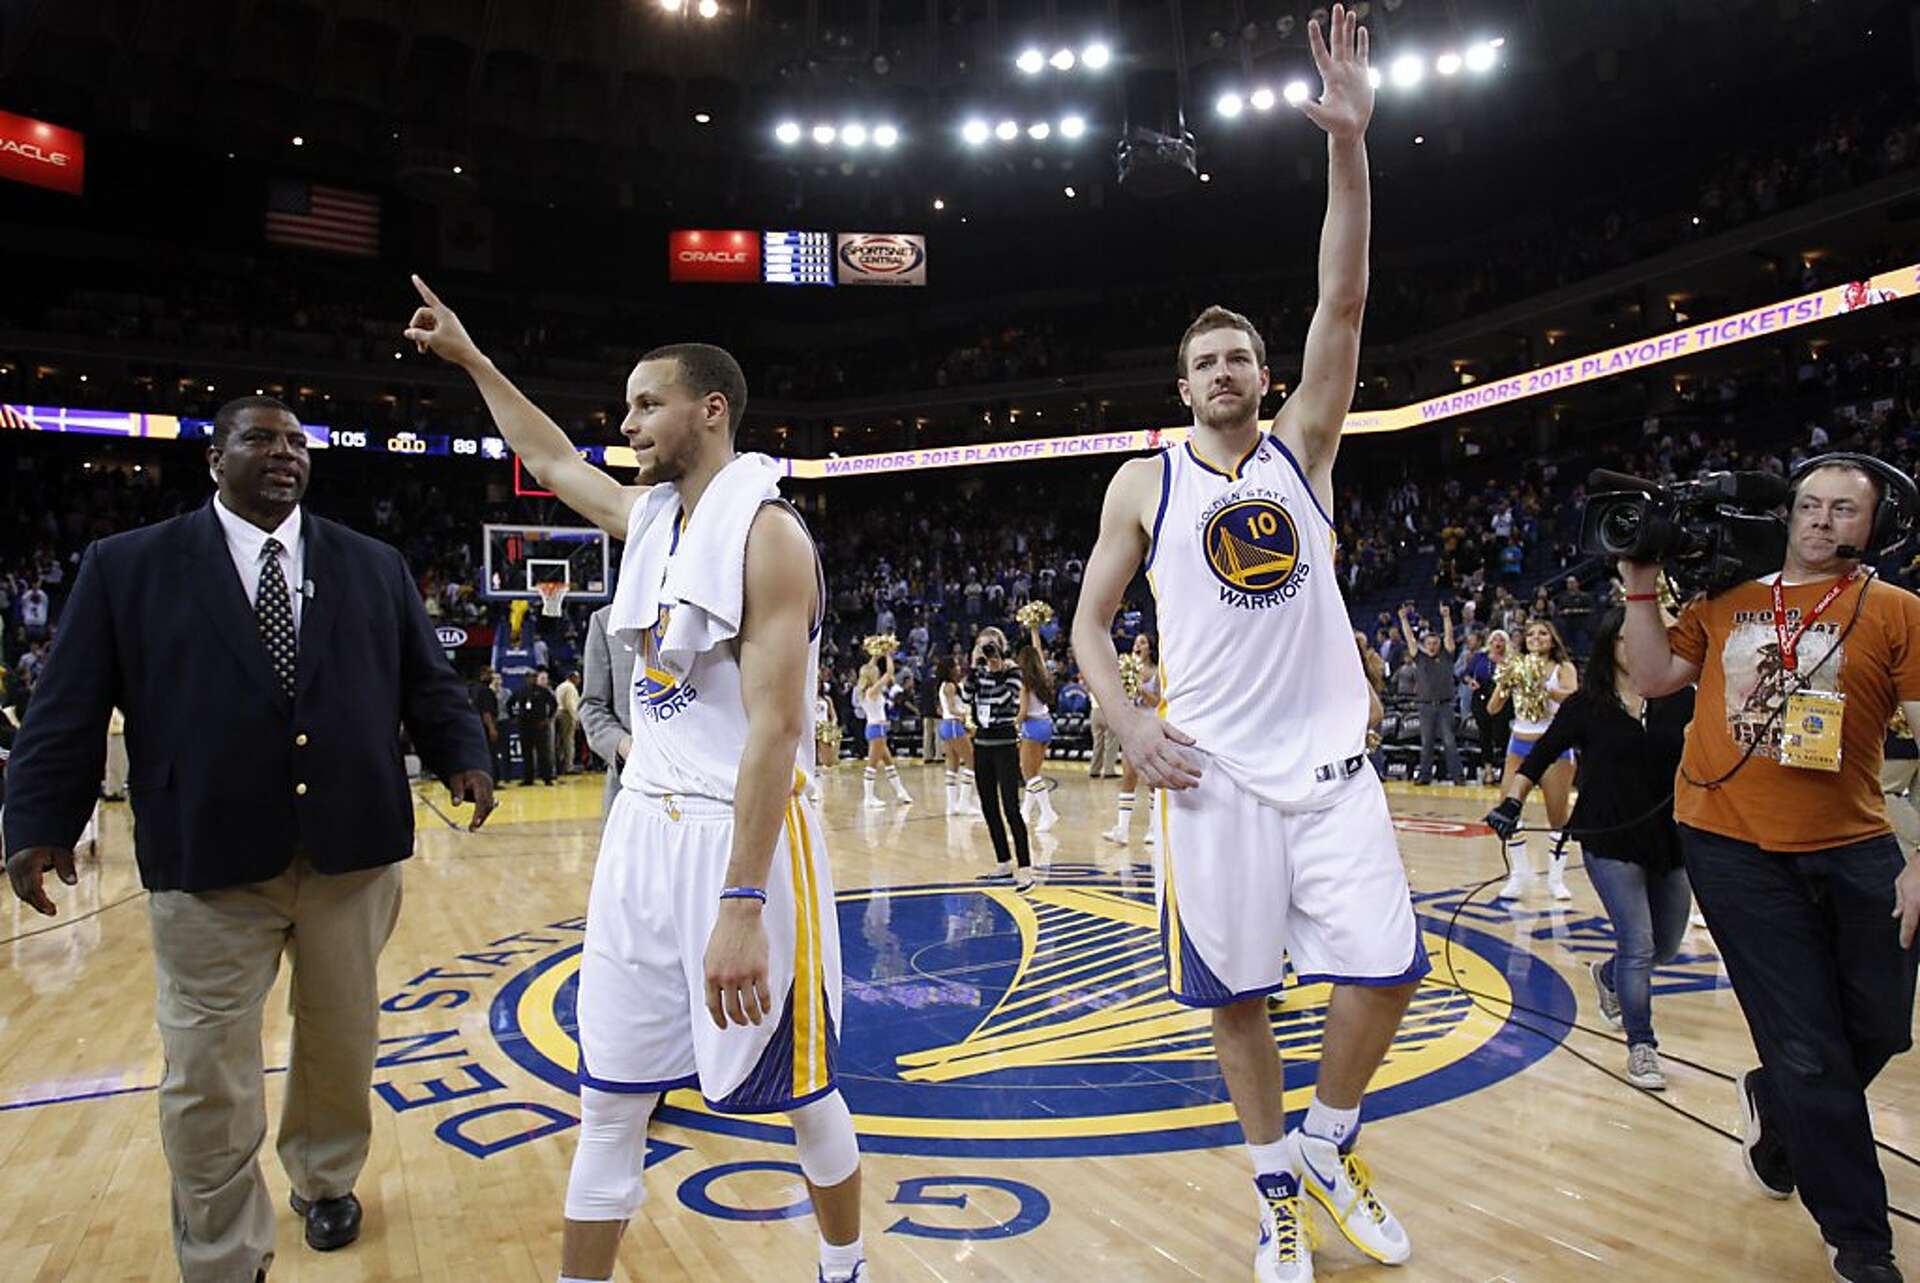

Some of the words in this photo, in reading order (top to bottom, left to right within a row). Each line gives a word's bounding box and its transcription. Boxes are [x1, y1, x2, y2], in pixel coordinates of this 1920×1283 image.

[0, 139, 68, 167] ACLE
[679, 250, 749, 263] ORACLE
[1422, 380, 1522, 418] WARRIORS
[1528, 366, 1576, 392] 2013
[1581, 334, 1688, 377] PLAYOFF
[1695, 297, 1824, 346] TICKETS!
[329, 431, 367, 447] 105
[453, 438, 478, 455] 89
[824, 454, 916, 474] WARRIORS
[920, 451, 960, 466] 2013
[964, 442, 1046, 462] PLAYOFF
[1051, 435, 1134, 454] TICKETS!
[1247, 511, 1278, 540] 10
[1219, 561, 1310, 610] WARRIORS
[438, 631, 461, 642] KIA
